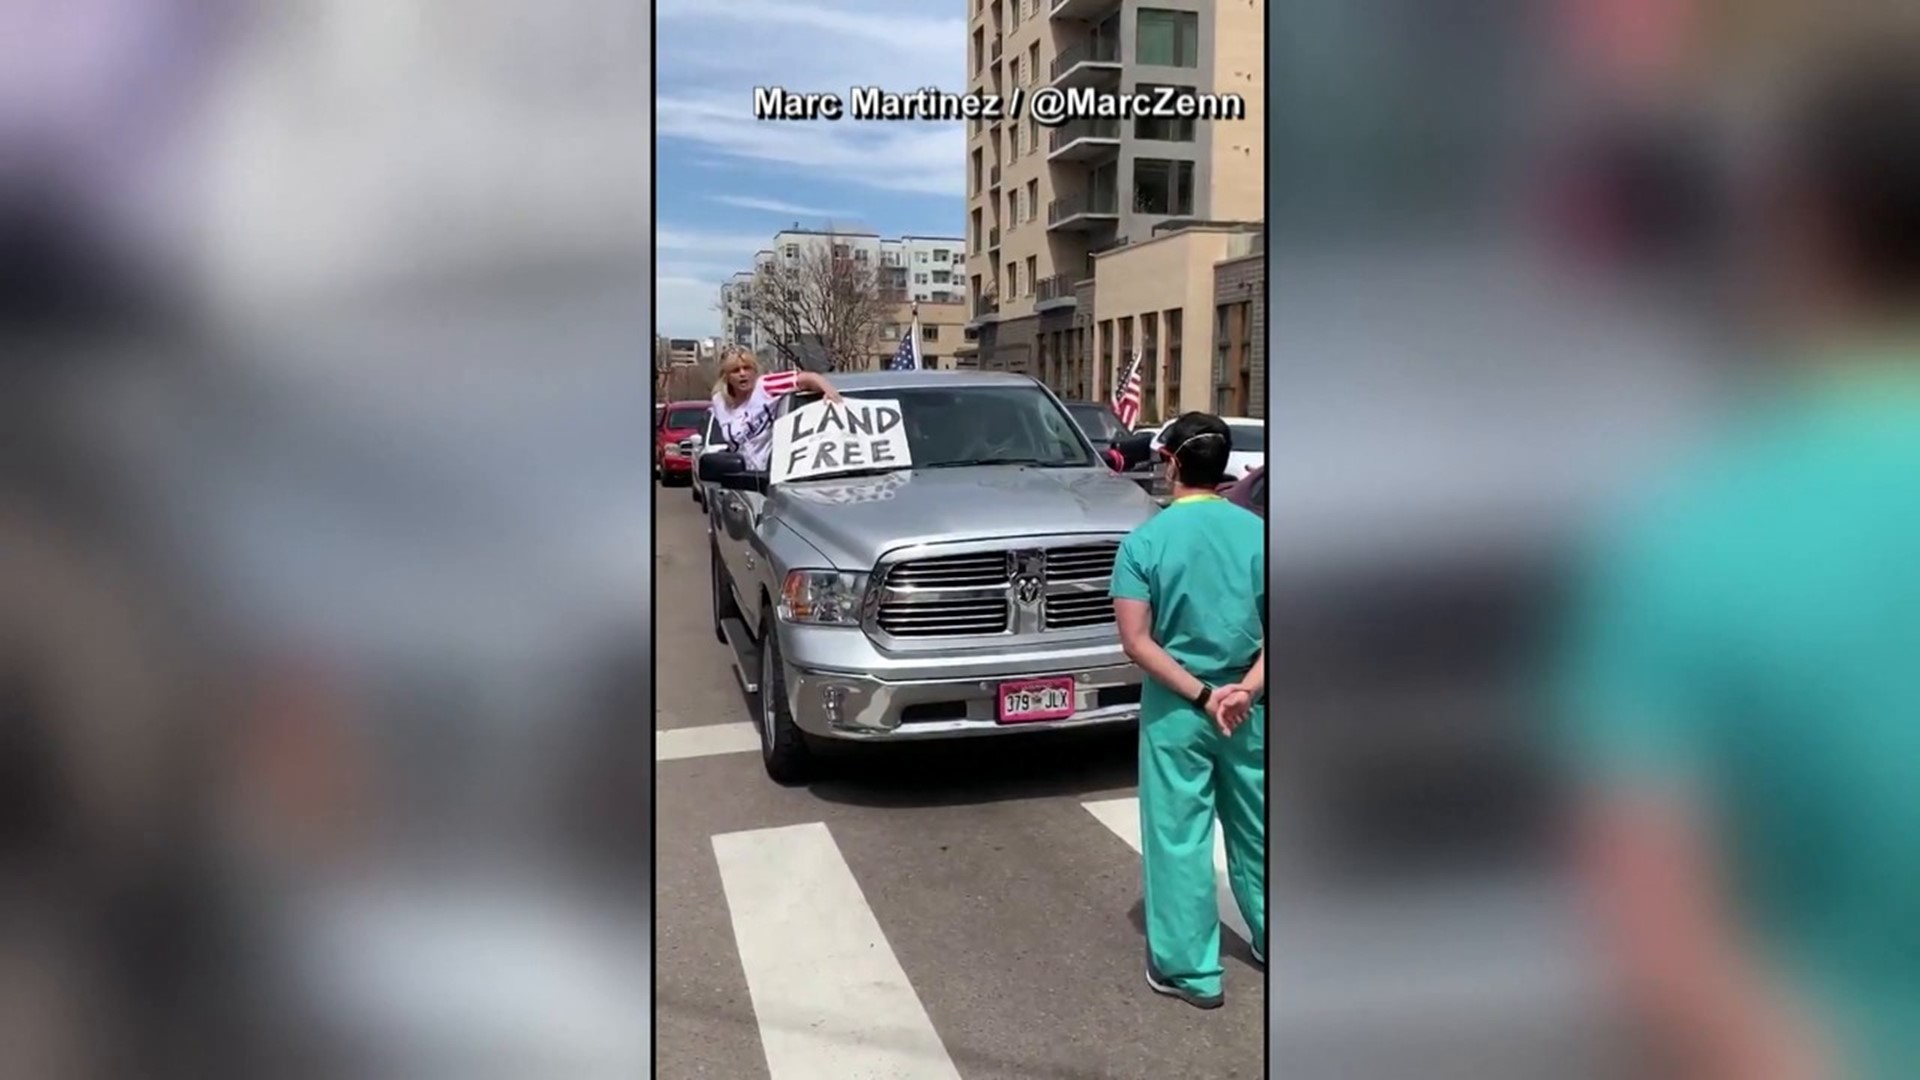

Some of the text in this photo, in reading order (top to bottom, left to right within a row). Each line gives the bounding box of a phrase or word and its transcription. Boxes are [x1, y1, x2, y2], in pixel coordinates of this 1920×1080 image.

[791, 402, 901, 443] LAND
[786, 440, 895, 475] FREE
[1007, 691, 1068, 712] 379 JLX
